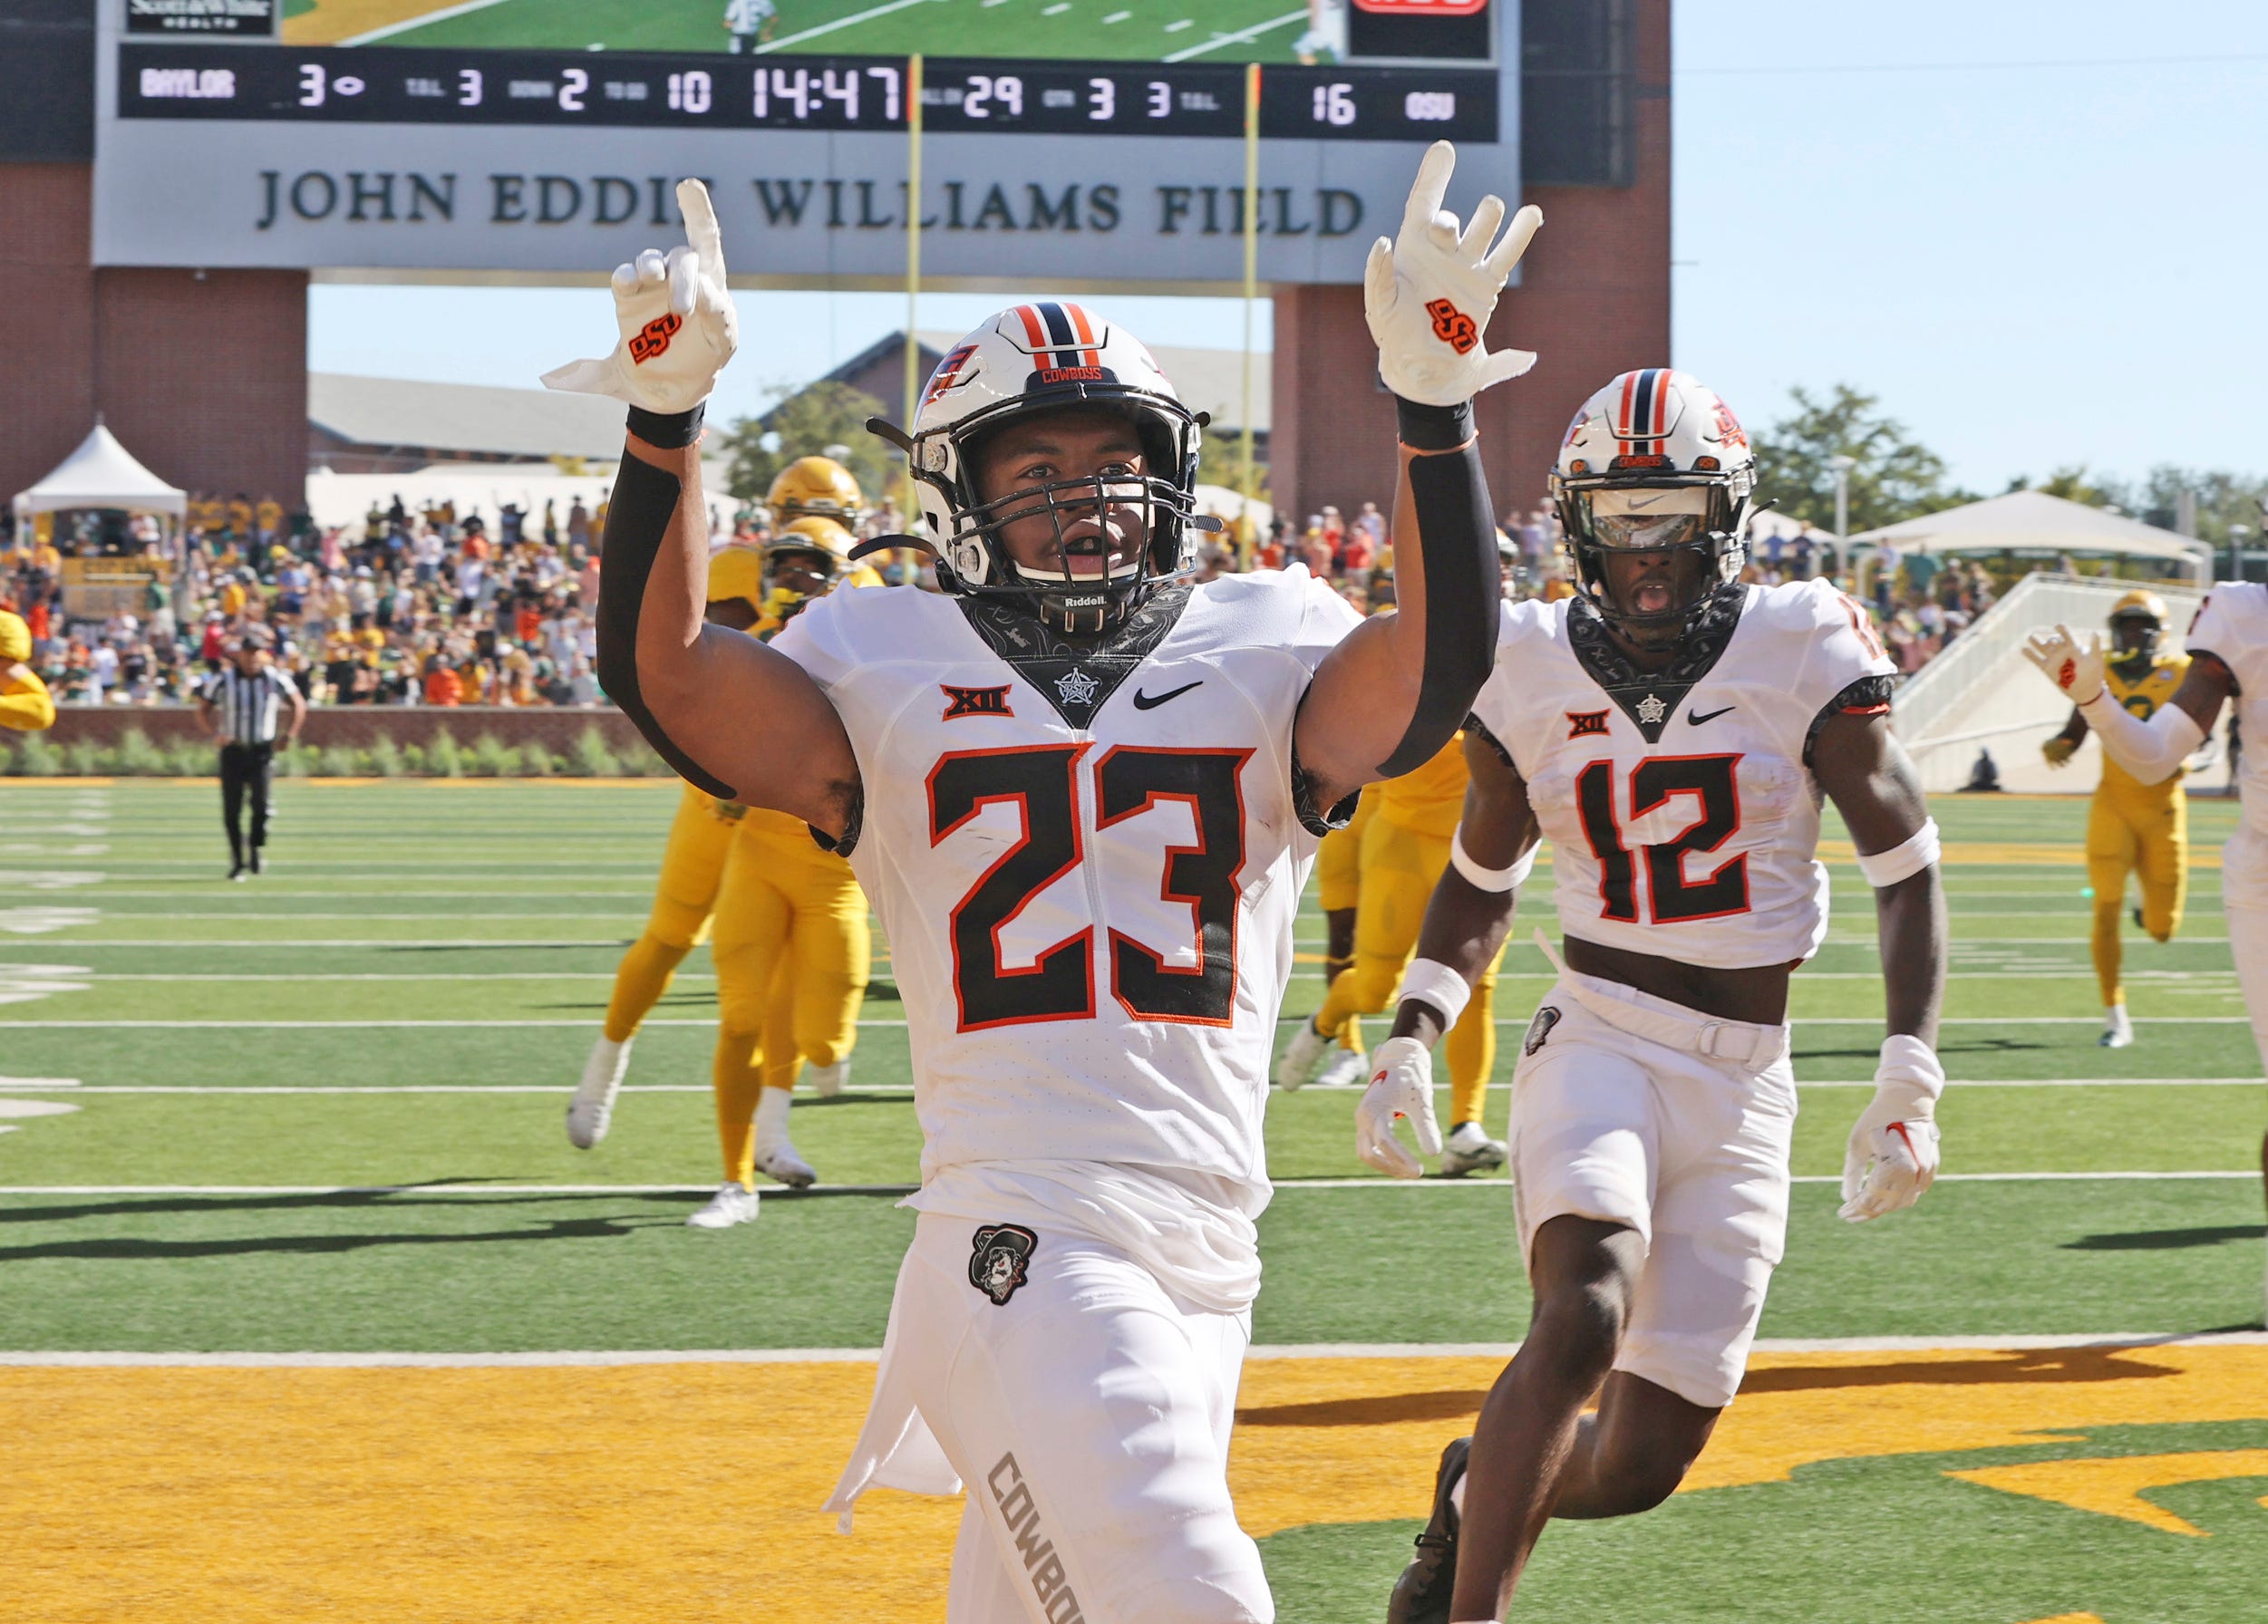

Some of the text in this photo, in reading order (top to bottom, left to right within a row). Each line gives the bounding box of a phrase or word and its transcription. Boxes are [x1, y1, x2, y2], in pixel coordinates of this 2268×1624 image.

[299, 64, 325, 106] 3
[459, 69, 482, 106] 3
[558, 69, 588, 111] 2
[668, 71, 712, 113] 10
[753, 68, 899, 120] 14:47
[964, 76, 1023, 118] 29
[1089, 78, 1115, 120] 3
[1148, 82, 1171, 118] 3
[1313, 83, 1356, 125] 16
[1405, 92, 1456, 121] OSU
[256, 171, 457, 230] JOHN
[754, 179, 1120, 233] WILLIAMS
[1158, 188, 1365, 237] FIELD
[1042, 367, 1102, 383] COWBOYS
[1064, 595, 1106, 607] Riddell
[1575, 752, 1751, 925] 12
[925, 741, 1258, 1033] 23
[988, 1451, 1086, 1624] COWBO
